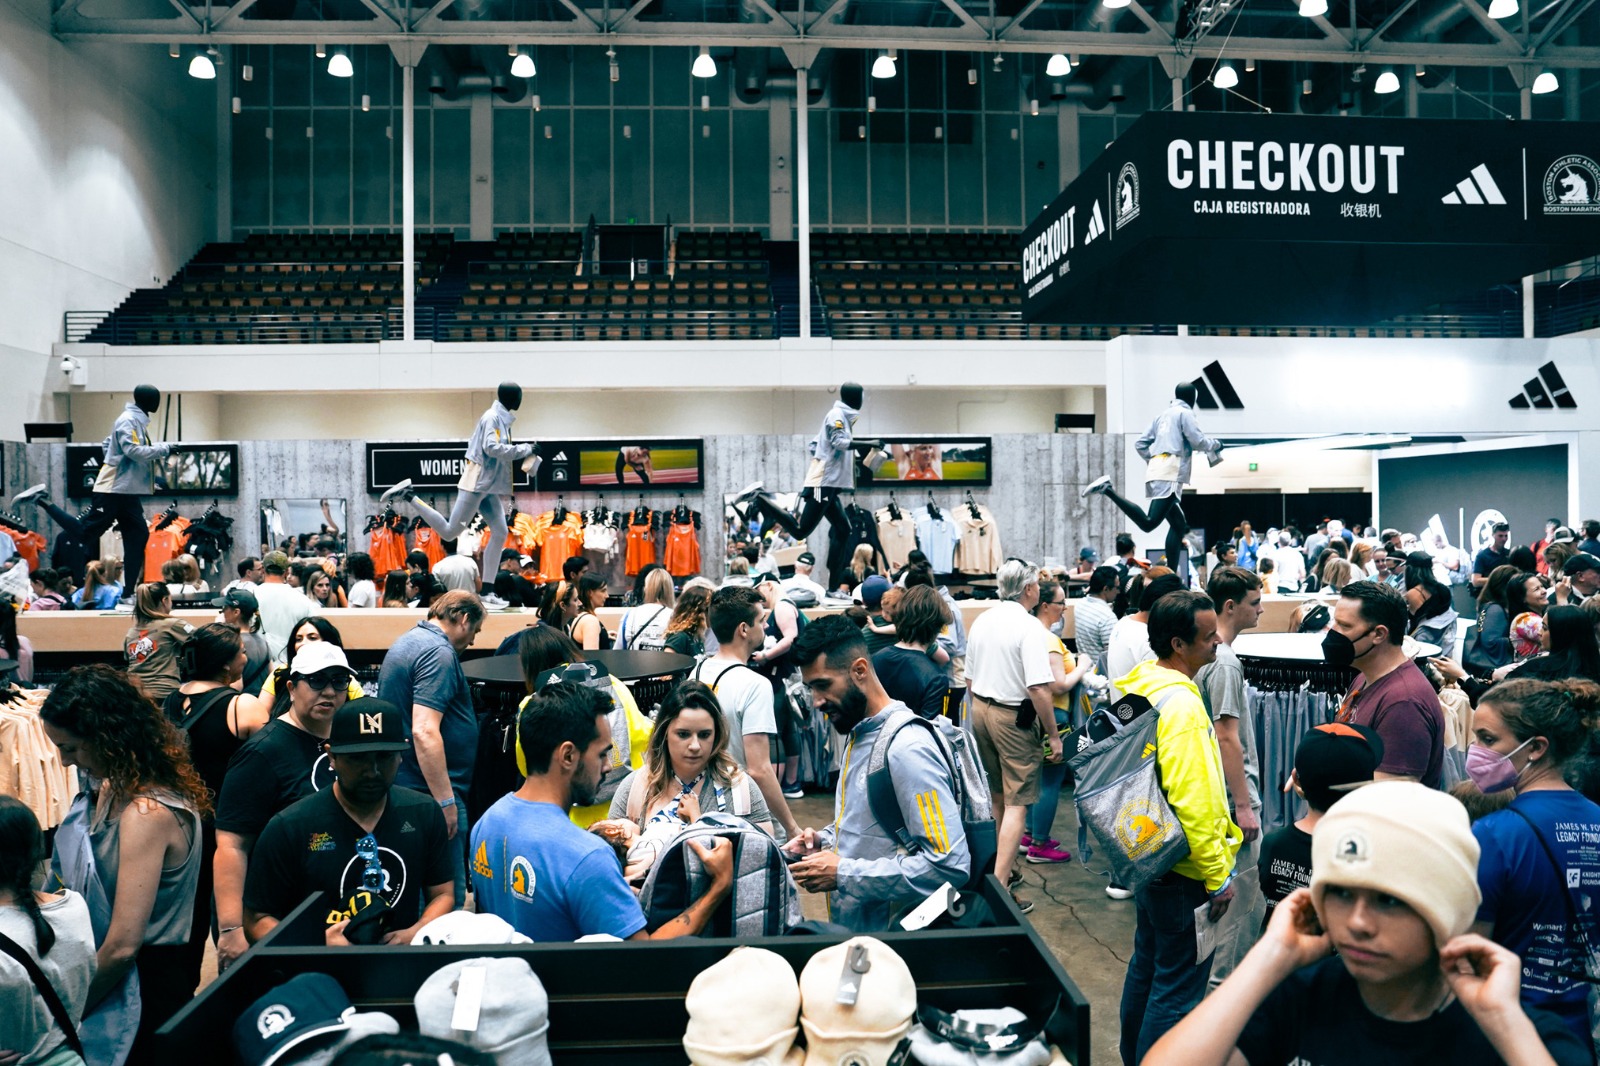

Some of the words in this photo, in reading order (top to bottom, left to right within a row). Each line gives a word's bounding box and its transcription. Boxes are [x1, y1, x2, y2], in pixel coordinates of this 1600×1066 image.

[1167, 138, 1405, 194] CHECKOUT
[1546, 172, 1555, 201] BOSTON
[1553, 157, 1581, 172] ATHLETIC
[1193, 200, 1223, 214] CAJA
[1226, 201, 1311, 215] REGISTRADORA
[1340, 202, 1382, 218] 收银机
[1023, 205, 1076, 284] CHECKOUT
[1555, 822, 1579, 831] JAMES
[1555, 831, 1580, 842] LEGACY
[1270, 864, 1294, 878] LEGACY
[1272, 858, 1296, 870] JAMES
